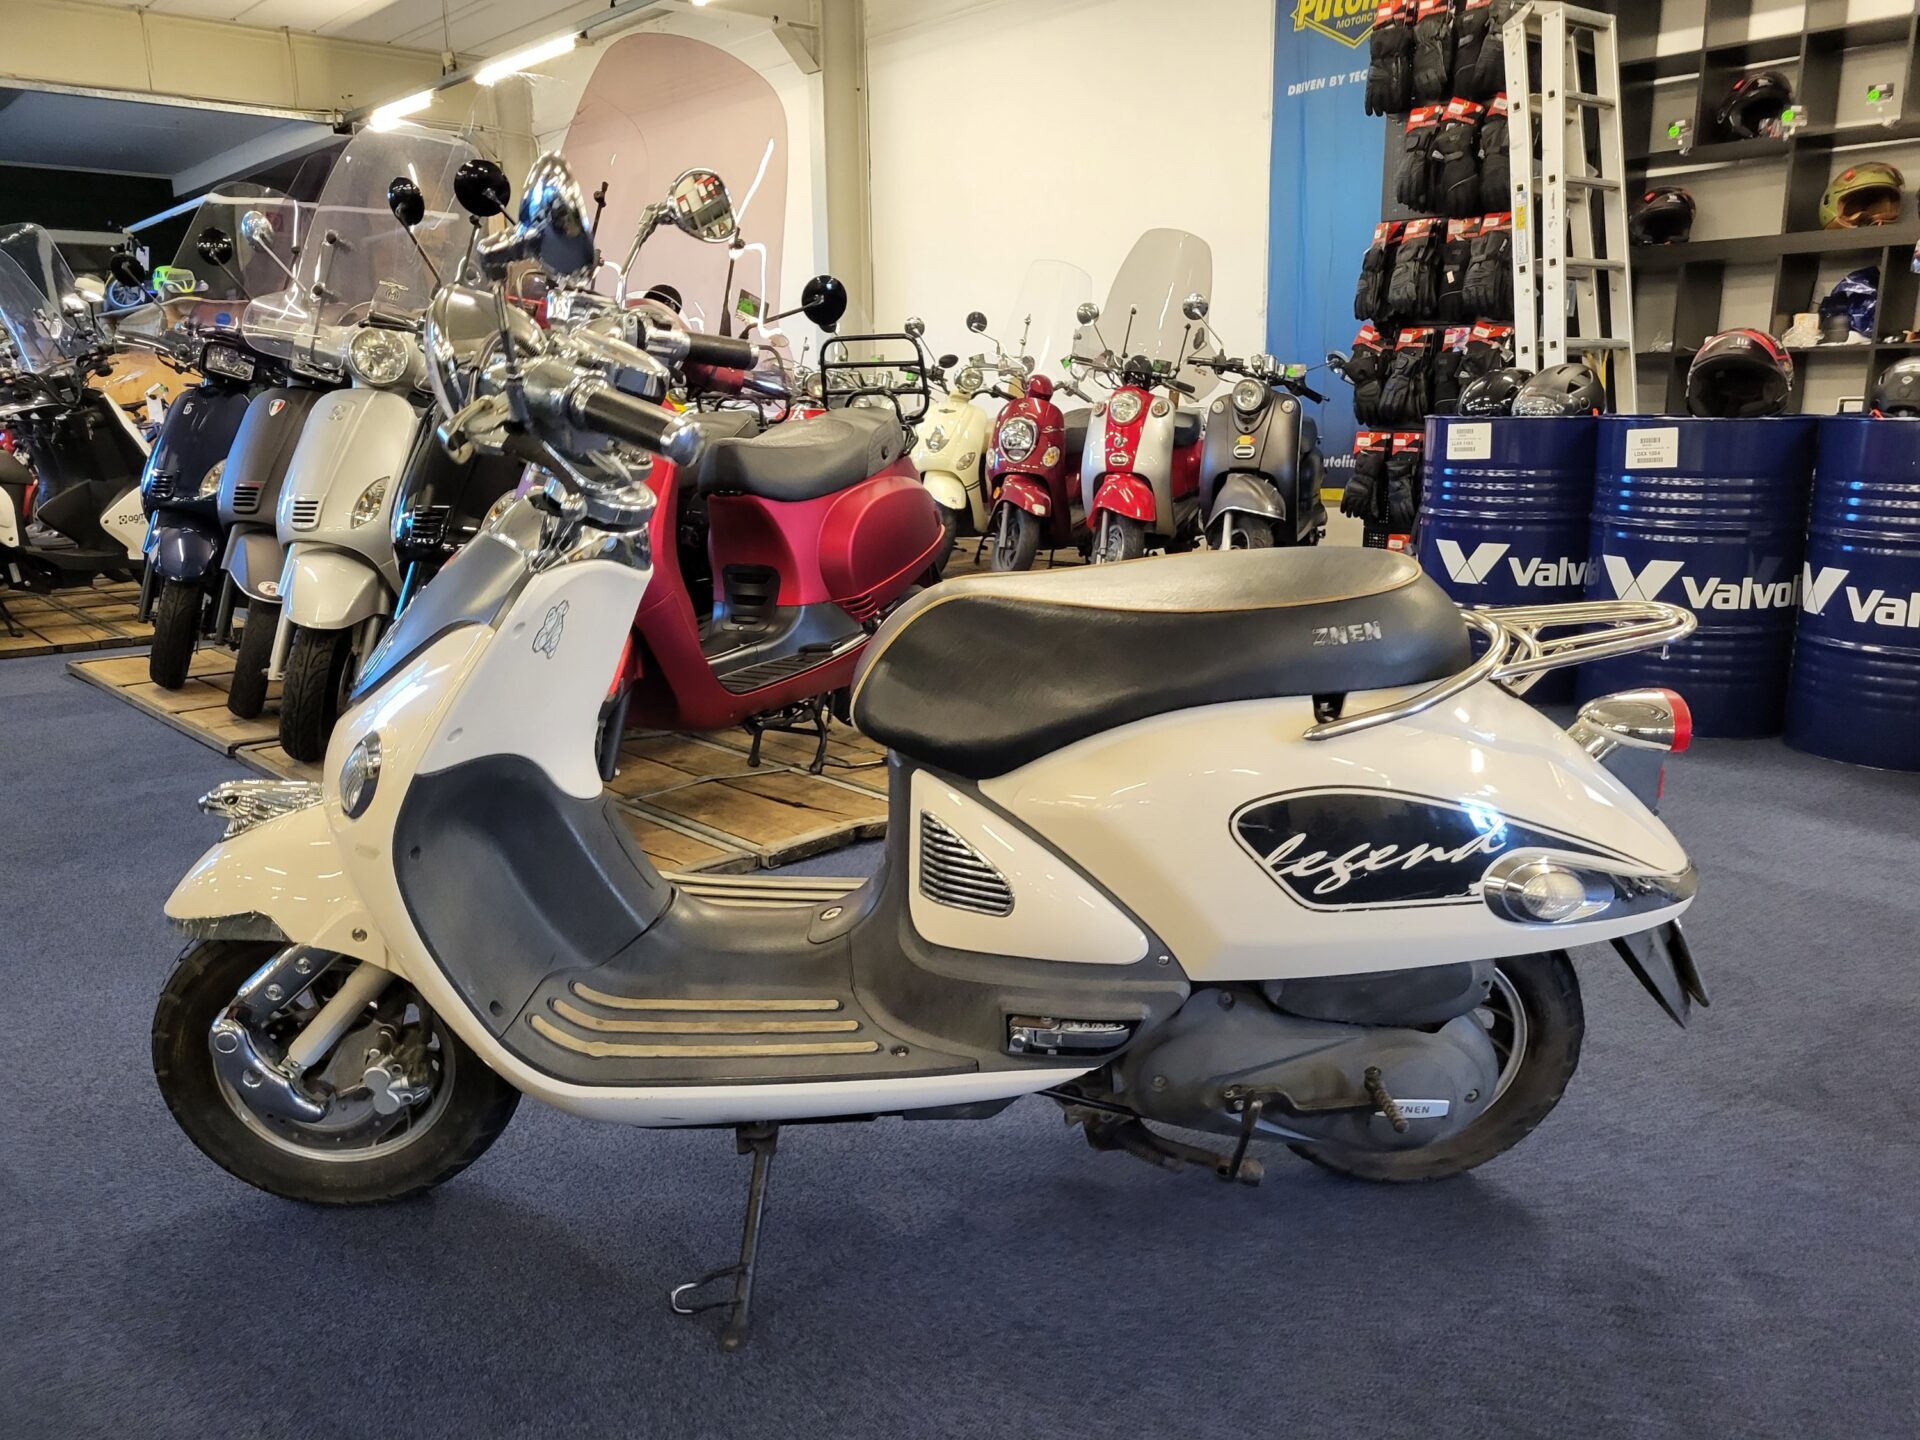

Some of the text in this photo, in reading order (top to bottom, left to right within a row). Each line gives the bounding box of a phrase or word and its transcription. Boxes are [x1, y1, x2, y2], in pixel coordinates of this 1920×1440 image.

[1287, 69, 1369, 96] DRIVEN BY TEC
[1312, 620, 1382, 646] ZNEN
[1399, 1105, 1430, 1114] ZNEN
